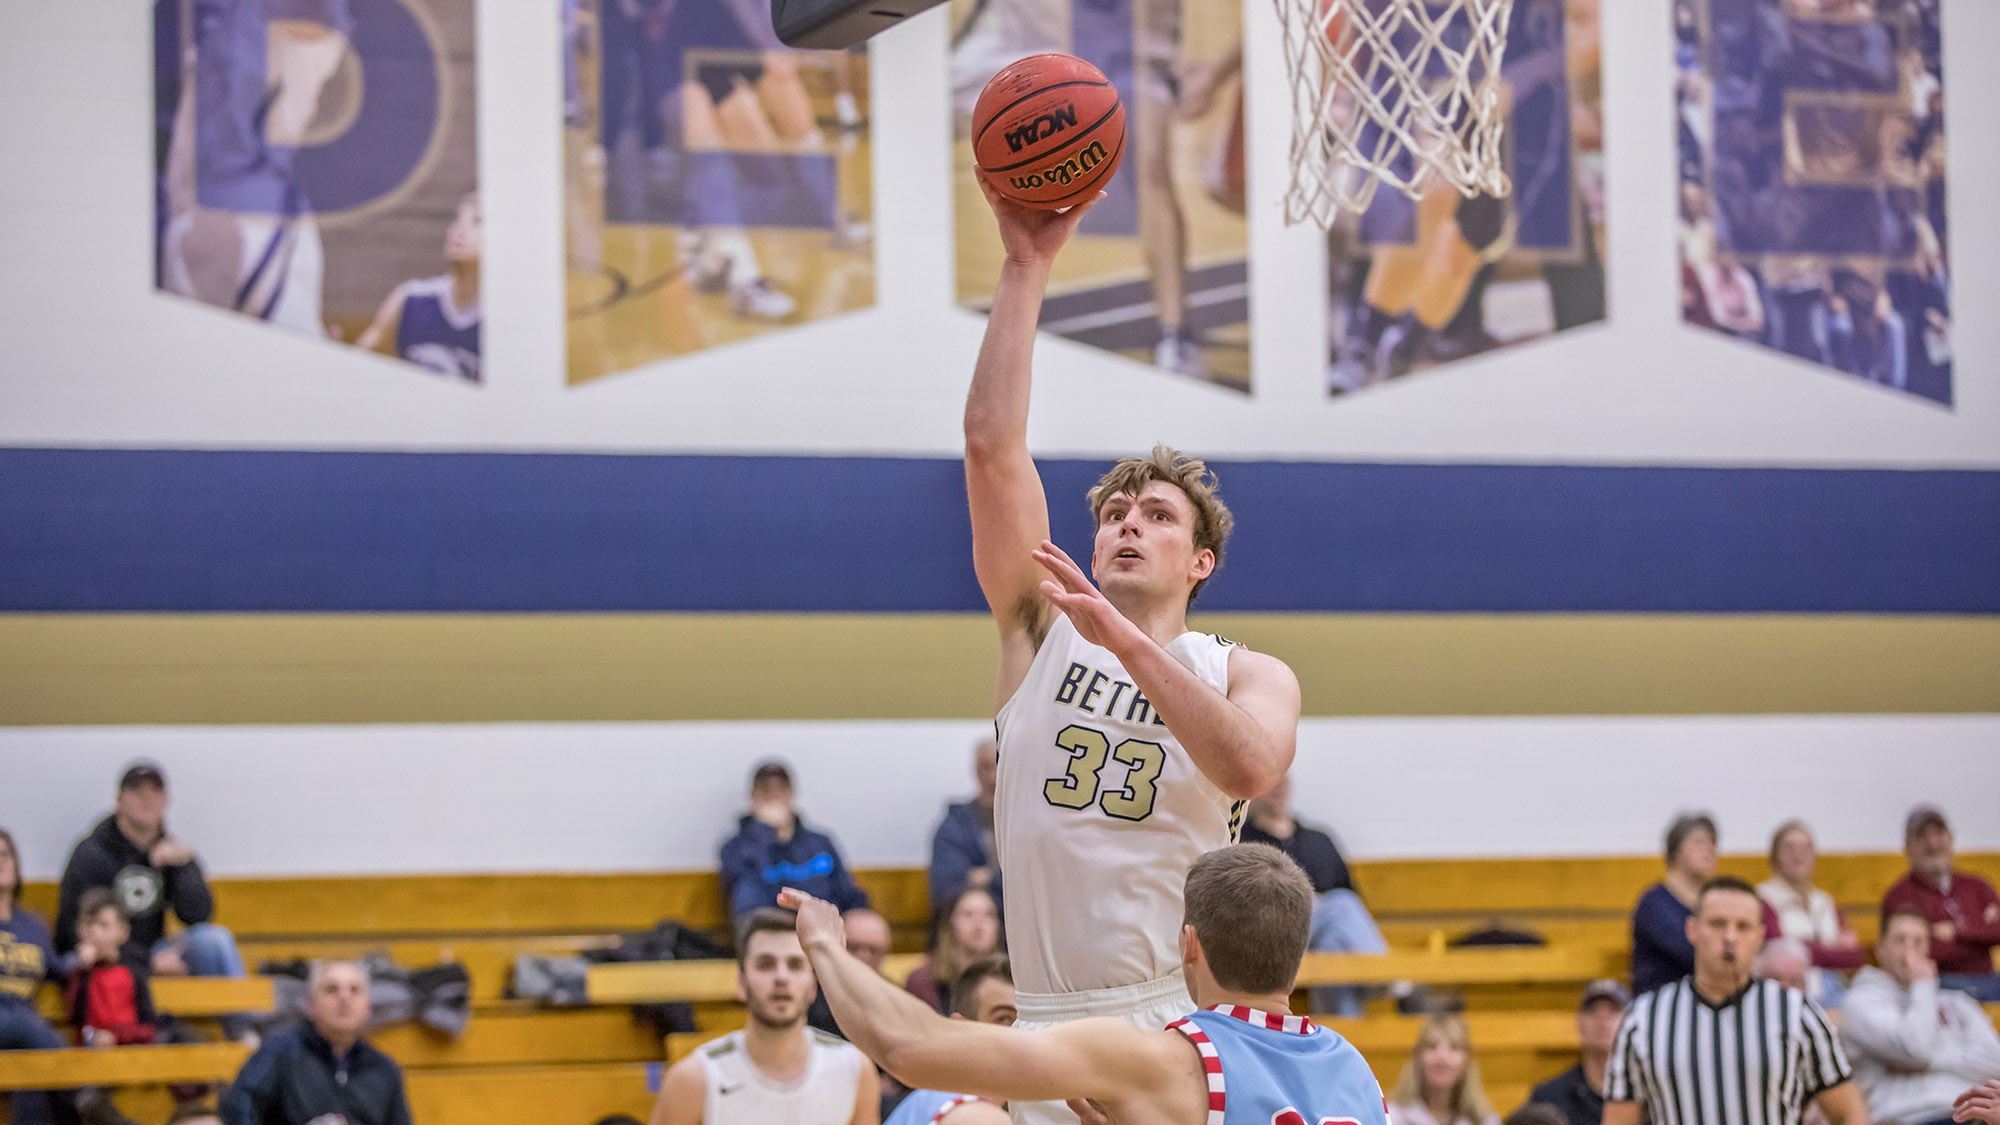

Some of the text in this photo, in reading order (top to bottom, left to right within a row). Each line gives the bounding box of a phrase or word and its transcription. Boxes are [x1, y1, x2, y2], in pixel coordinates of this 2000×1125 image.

[1004, 103, 1079, 153] NCAA
[1009, 140, 1108, 190] Wilson
[1053, 661, 1167, 727] BETH
[1042, 723, 1167, 822] 33
